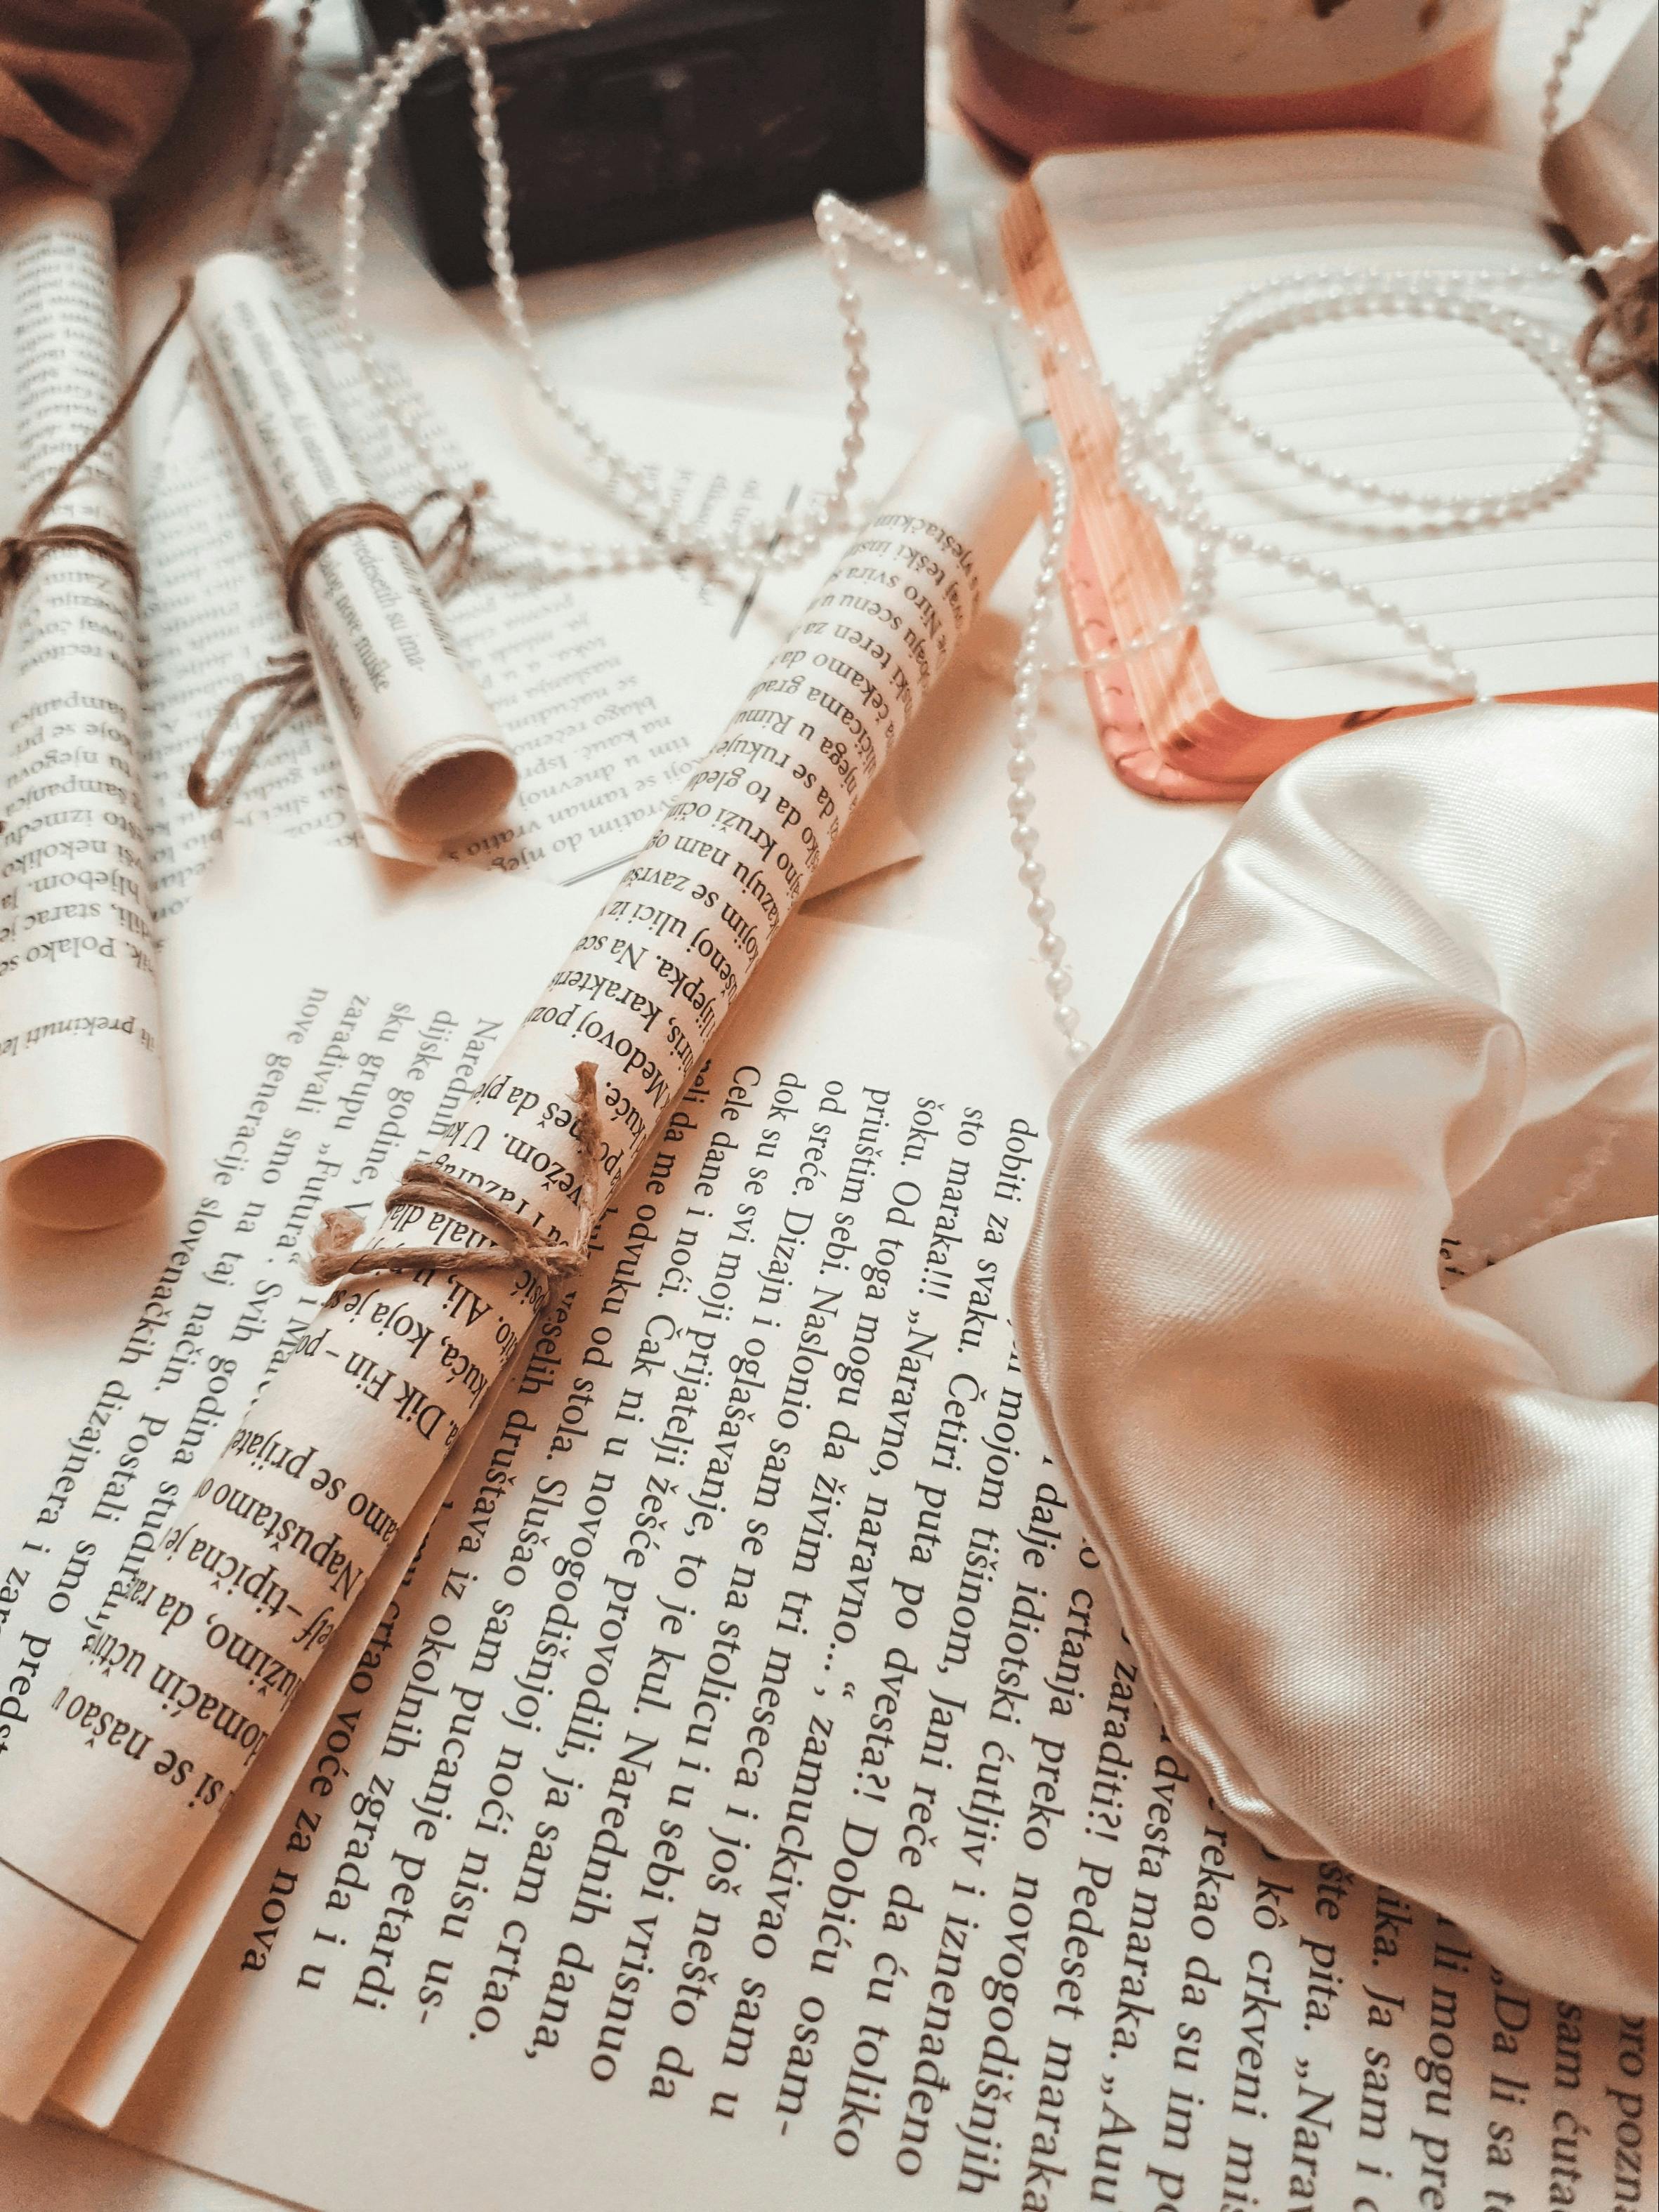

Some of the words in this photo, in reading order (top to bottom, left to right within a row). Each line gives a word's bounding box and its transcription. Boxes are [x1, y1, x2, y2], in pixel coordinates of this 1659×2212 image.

[838, 593, 903, 631] scenu
[845, 566, 900, 588] svira
[903, 584, 943, 640] Niro
[834, 626, 893, 670] teren
[813, 653, 890, 724] čekamo
[792, 763, 818, 789] se
[819, 735, 857, 796] njega
[711, 808, 778, 863] kruži
[775, 795, 801, 829] da
[674, 835, 730, 867] nam
[628, 903, 687, 938] ulici
[691, 883, 719, 907] se
[610, 938, 649, 970] Na
[285, 987, 329, 1045] nove
[376, 1001, 416, 1043] sku
[405, 1009, 459, 1081] dijske
[294, 994, 370, 1114] zarađivali
[571, 1010, 669, 1108] Medovoj
[212, 1052, 291, 1186] generacije
[333, 1051, 385, 1131] grupu
[506, 1086, 539, 1117] da
[605, 1081, 645, 1145] kuće.
[719, 1065, 761, 1121] Cele
[766, 1072, 806, 1121] dok
[818, 1080, 846, 1114] od
[261, 1130, 301, 1185] smo
[351, 1086, 415, 1185] godine,
[755, 1128, 780, 1158] su
[791, 1121, 831, 1196] sreće.
[900, 1096, 945, 1166] šoku.
[957, 1107, 985, 1146] sto
[993, 1118, 1038, 1202] dobiti
[693, 1131, 739, 1197] dane
[744, 1166, 768, 1195] se
[233, 1201, 265, 1233] na
[685, 1206, 713, 1217] i
[726, 1202, 756, 1243] svi
[885, 1180, 922, 1227] Od
[918, 1157, 970, 1300] maraka!!!
[983, 1212, 1009, 1244] za
[117, 1199, 222, 1364] slovenačkih
[201, 1251, 244, 1286] taj
[657, 1226, 698, 1298] noći.
[697, 1250, 741, 1321] moji
[756, 1207, 814, 1304] Dizajn
[860, 1238, 904, 1300] toga
[229, 1279, 282, 1342] Svih
[370, 1301, 435, 1359] koja
[442, 1275, 493, 1327] Ali,
[752, 1315, 780, 1327] i
[957, 1258, 998, 1353] svaku.
[153, 1302, 214, 1391] način.
[344, 1350, 397, 1402] Fin
[440, 1335, 488, 1409] kuća,
[630, 1314, 683, 1377] Čak
[833, 1311, 879, 1406] mogu
[171, 1353, 237, 1465] godina
[393, 1380, 447, 1440] Dik
[614, 1387, 644, 1423] ni
[650, 1325, 716, 1466] prijatelji
[869, 1308, 938, 1476] „Naravno,
[931, 1373, 988, 1471] Četiri
[35, 1378, 131, 1525] dizajnera
[90, 1413, 169, 1522] Postali
[603, 1436, 629, 1456] u
[683, 1337, 766, 1536] oglašavanje,
[822, 1419, 860, 1459] da
[977, 1385, 1023, 1510] mojom
[310, 1468, 347, 1500] se
[211, 1483, 364, 1601] Napuštamo
[622, 1474, 679, 1568] žešće
[792, 1473, 847, 1572] živim
[908, 1480, 947, 1563] puta
[1016, 1482, 1068, 1568] dalje
[47, 1539, 97, 1614] smo
[501, 1469, 615, 1732] novogodišnjoj
[674, 1553, 707, 1588] to
[891, 1576, 925, 1629] po
[936, 1527, 999, 1673] tišinom,
[156, 1593, 194, 1635] da
[655, 1594, 696, 1635] je
[775, 1590, 813, 1635] tri
[555, 1572, 637, 1758] provodili,
[633, 1644, 686, 1714] kul.
[988, 1581, 1047, 1725] idiotski
[1042, 1588, 1096, 1716] crtanja
[65, 1694, 154, 1760] našao
[733, 1645, 791, 1787] meseca
[852, 1647, 918, 1803] dvesta?!
[919, 1688, 967, 1770] Jani
[153, 1749, 194, 1786] se
[1084, 1661, 1150, 1842] zaraditi?!
[188, 1772, 224, 1808] si
[474, 1744, 523, 1834] noći
[542, 1766, 584, 1808] ja
[725, 1803, 759, 1820] i
[956, 1740, 1015, 1867] ćutljiv
[1023, 1732, 1065, 1851] preko
[1137, 1753, 1192, 1878] dvesta
[569, 1730, 659, 1924] Narednih
[752, 1713, 834, 1959] zamuckivao
[898, 1782, 938, 1867] reče
[440, 1847, 489, 1939] nisu
[512, 1821, 559, 1904] sam
[705, 1826, 751, 1896] još
[809, 1817, 879, 1974] Dobiću
[951, 1880, 985, 1897] i
[1190, 1825, 1241, 1940] rekao
[881, 1883, 924, 1932] da
[1252, 1875, 1296, 1930] kô
[670, 1908, 721, 2027] nešto
[1052, 1856, 1113, 2020] Pedeset
[418, 1958, 454, 2024] us-
[468, 1919, 527, 2040] crtao.
[524, 1942, 594, 2059] dana,
[866, 1951, 909, 2003] ću
[1109, 1887, 1158, 2060] maraka.
[1180, 1955, 1222, 2006] da
[1298, 1933, 1344, 2031] pita.
[1361, 1984, 1405, 2028] Ja
[721, 1977, 766, 2067] sam
[896, 1911, 979, 2177] iznenađeno
[955, 1871, 1039, 2194] novogodišnjih
[1173, 2022, 1202, 2072] su
[1231, 1949, 1282, 2119] crkveni
[648, 2045, 694, 2098] da
[775, 1996, 825, 2135] osam-
[833, 2024, 889, 2157] toliko
[1358, 2046, 1390, 2140] sam
[709, 2091, 738, 2119] u
[1021, 2036, 1072, 2212] maraka
[1162, 2087, 1204, 2150] im
